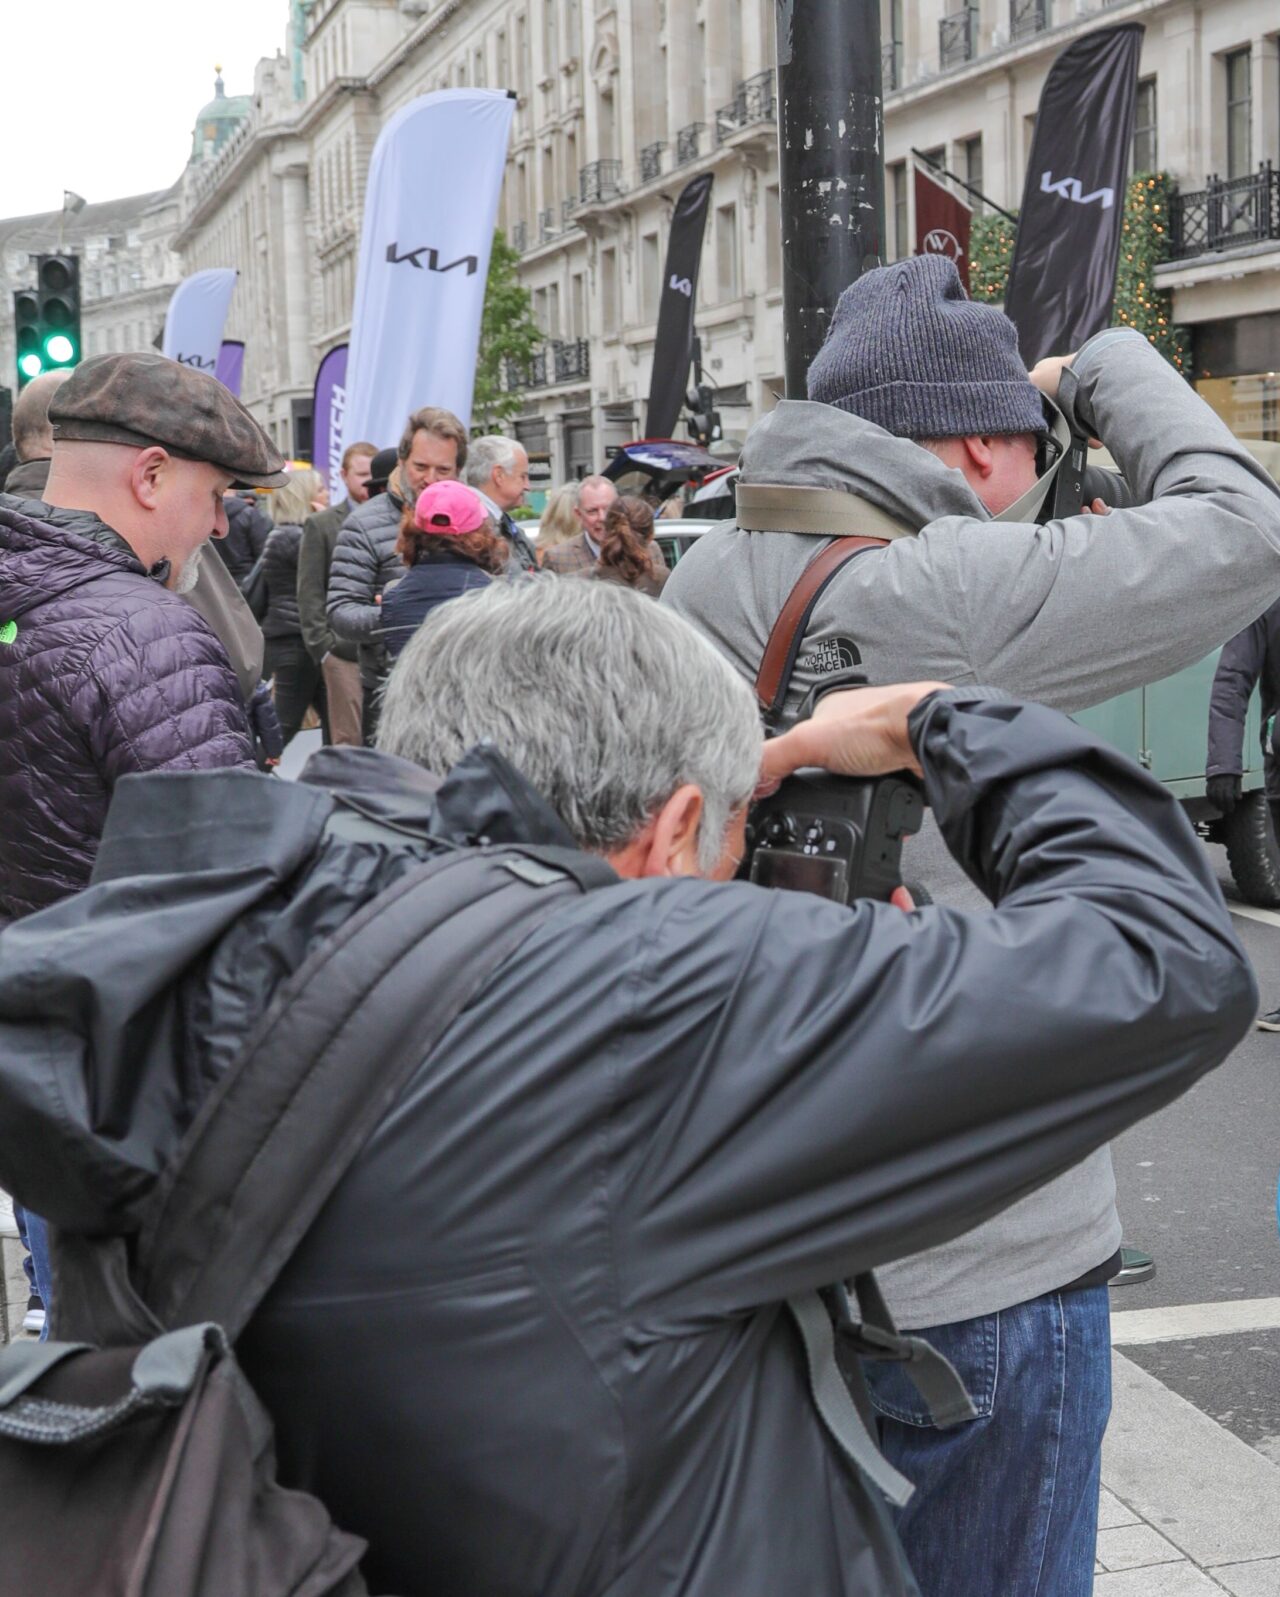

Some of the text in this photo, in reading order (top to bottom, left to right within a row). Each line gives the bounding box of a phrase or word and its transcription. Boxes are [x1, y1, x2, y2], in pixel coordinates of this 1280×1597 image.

[1040, 170, 1115, 210] KIA
[385, 242, 478, 276] KIA
[817, 639, 837, 651] THE
[804, 651, 839, 667] NORTH
[813, 660, 840, 674] FACE
